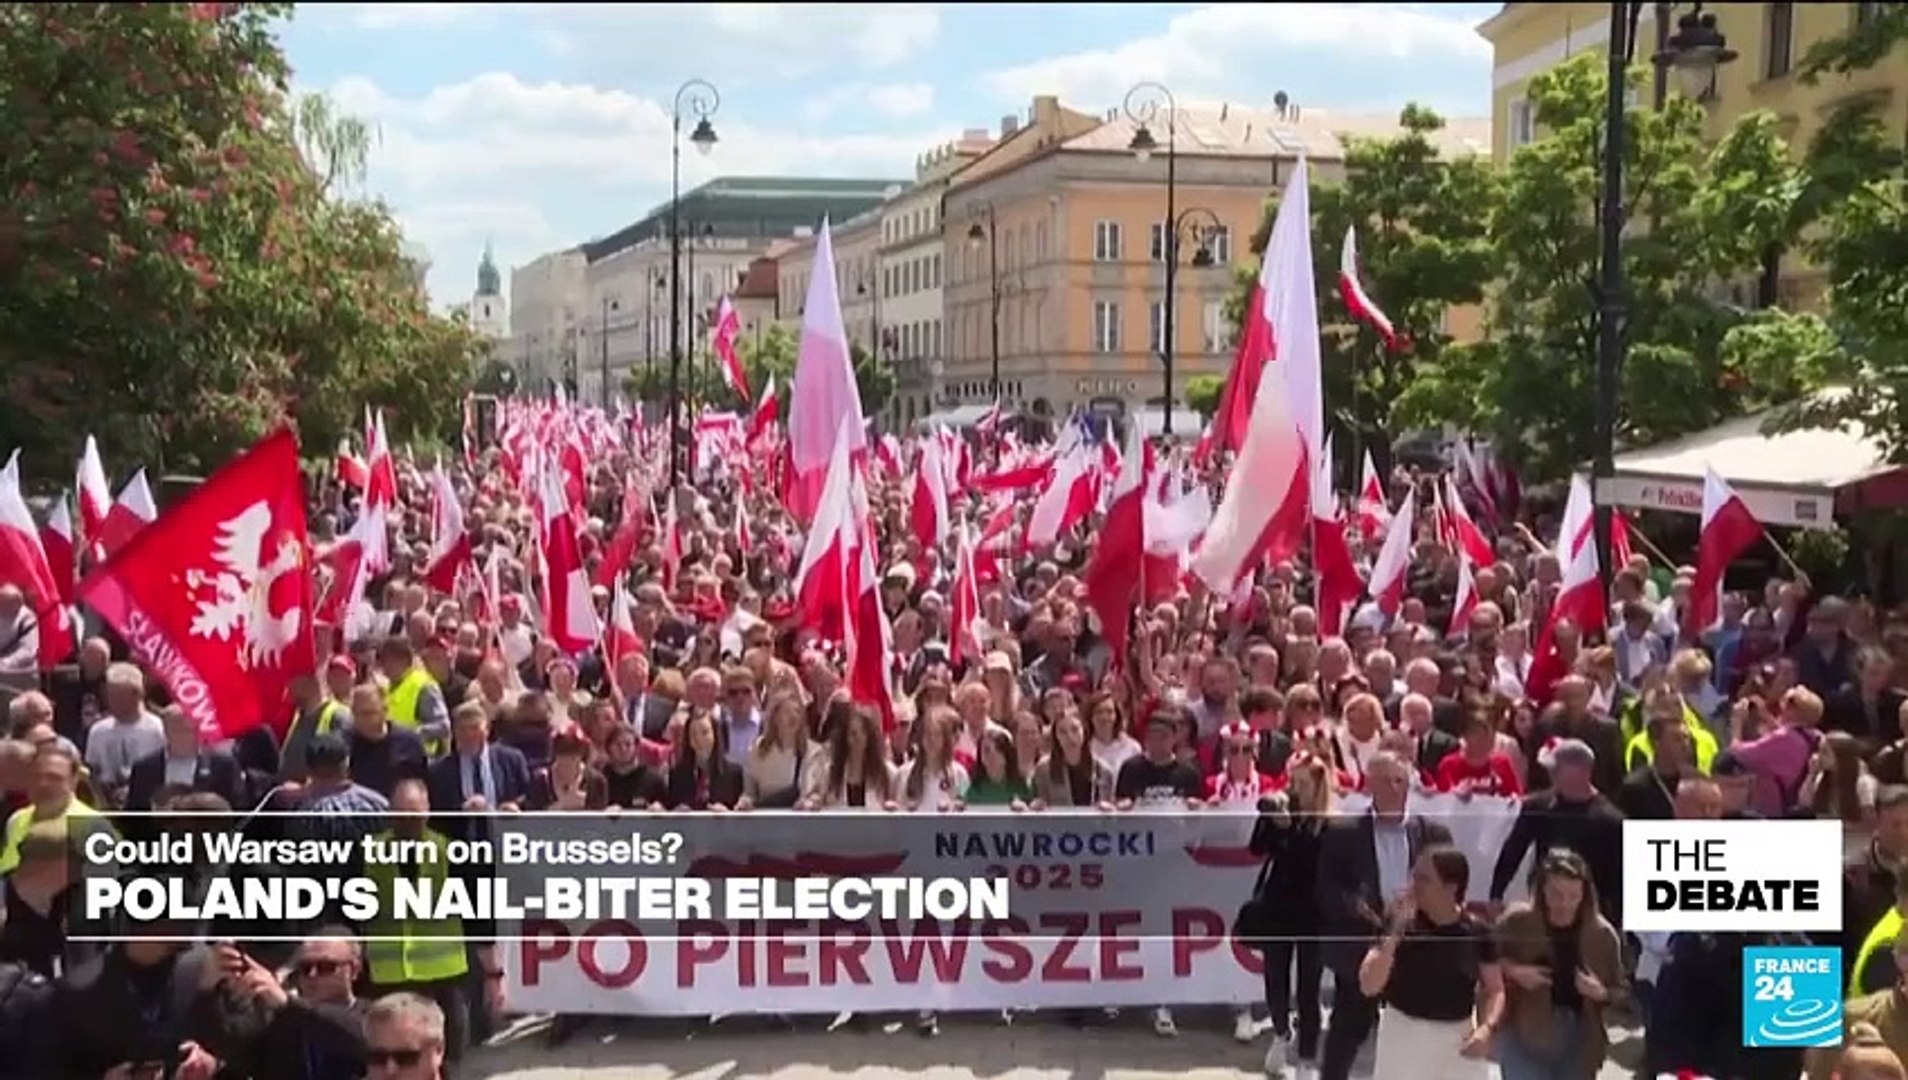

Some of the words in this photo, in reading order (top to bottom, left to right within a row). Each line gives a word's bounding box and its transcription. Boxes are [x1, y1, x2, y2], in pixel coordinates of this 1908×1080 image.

[935, 831, 1155, 858] NAWROCKI
[985, 863, 1105, 890] 2025
[521, 917, 648, 988] PO
[676, 910, 1145, 988] PIERWSZE
